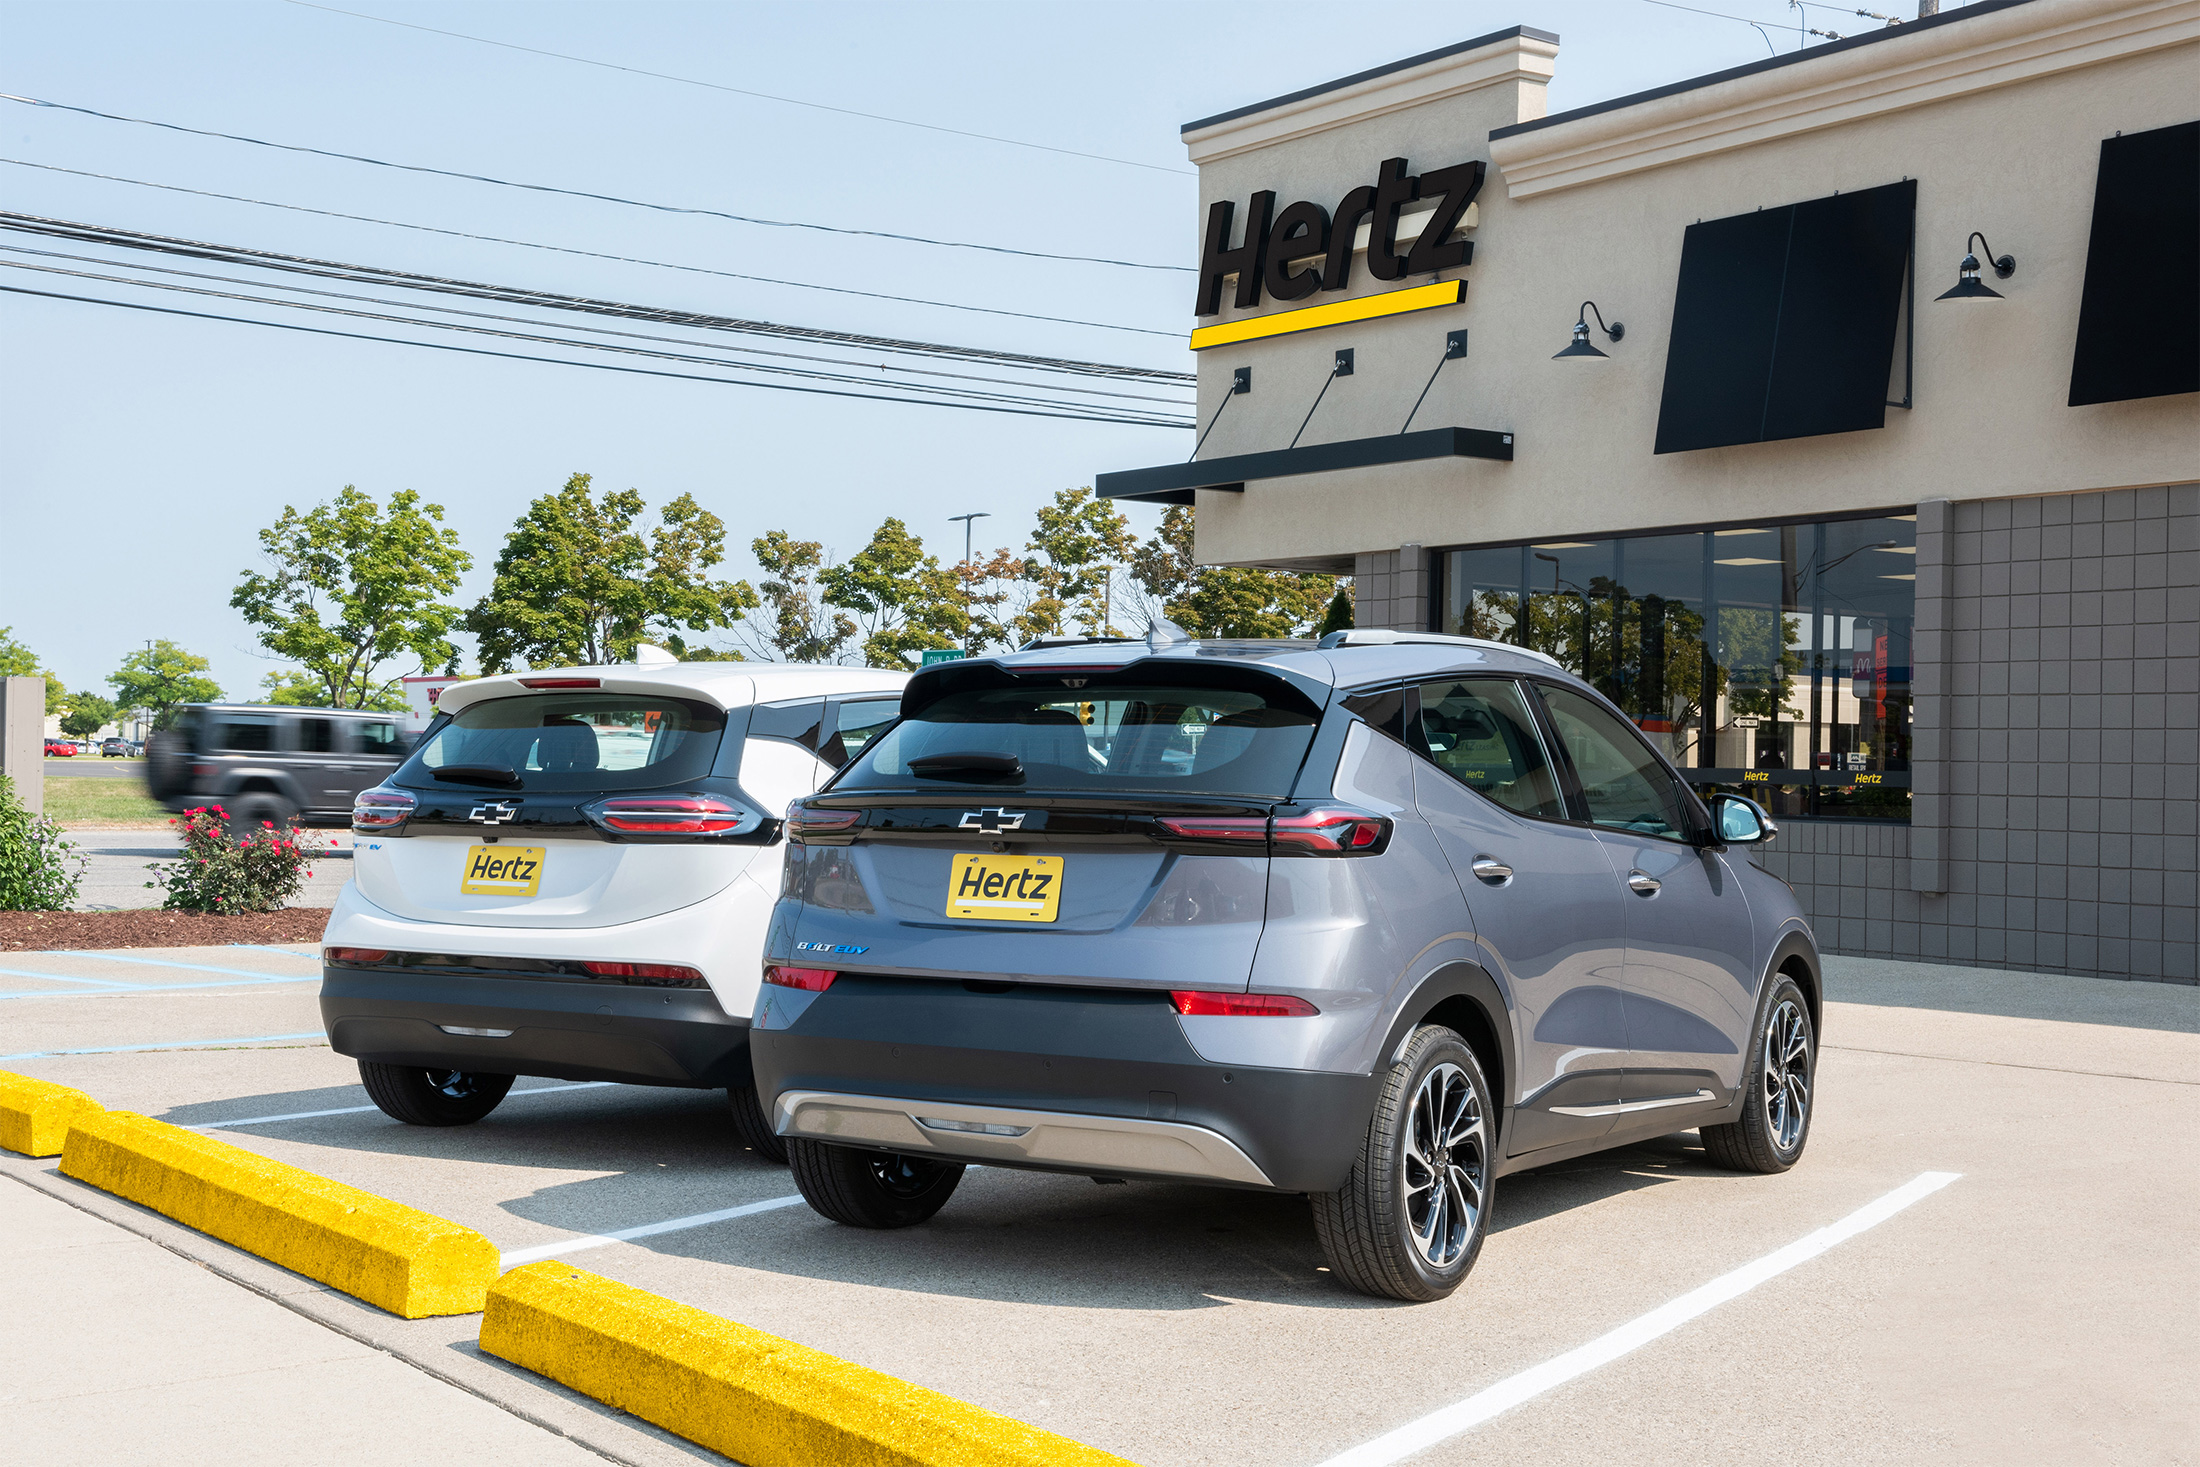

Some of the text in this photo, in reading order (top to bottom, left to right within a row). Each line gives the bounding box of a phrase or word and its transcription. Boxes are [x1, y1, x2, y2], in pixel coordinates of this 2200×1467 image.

[1194, 157, 1487, 317] Hertz
[1466, 770, 1485, 778] Hertz
[1744, 771, 1769, 781] Hertz
[1855, 773, 1882, 784] Hertz
[470, 855, 538, 880] Hertz
[958, 866, 1053, 899] Hertz
[834, 945, 870, 955] EUV
